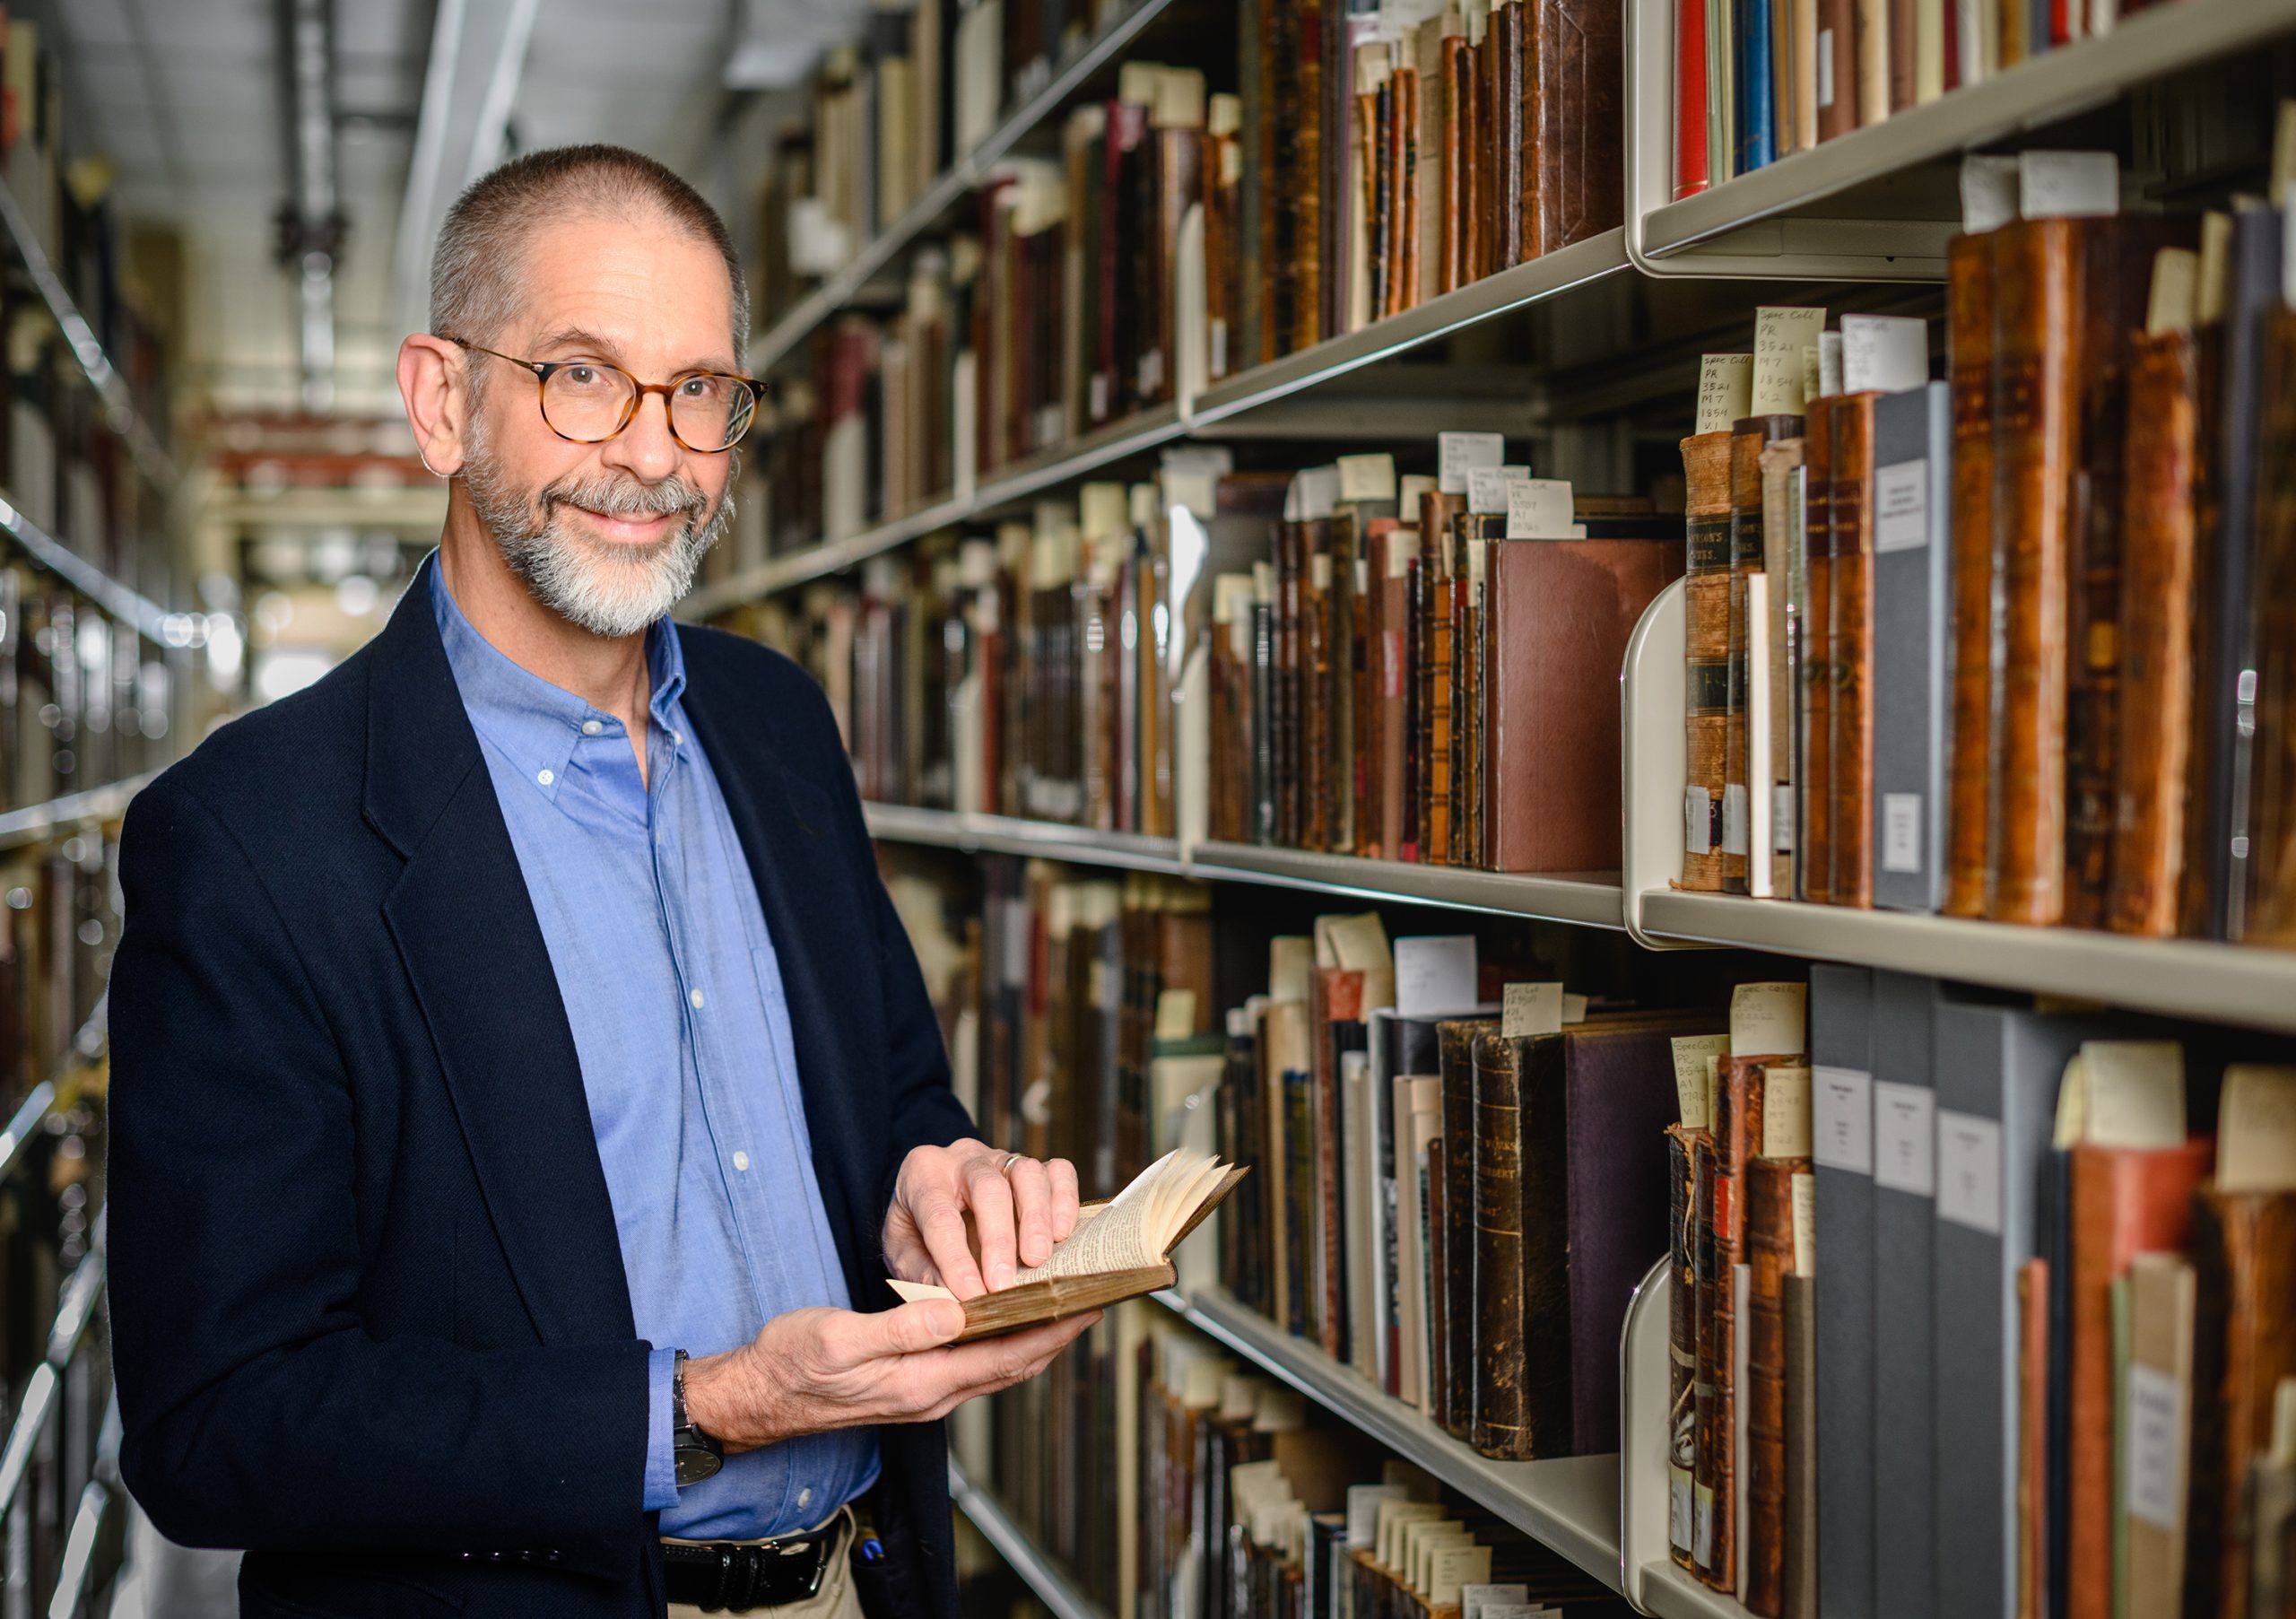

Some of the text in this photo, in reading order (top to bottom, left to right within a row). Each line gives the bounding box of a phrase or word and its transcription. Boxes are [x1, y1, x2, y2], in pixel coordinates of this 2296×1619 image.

[1760, 323, 1778, 336] PR
[1705, 369, 1718, 379] PR
[1702, 382, 1729, 392] 3521
[1701, 408, 1728, 418] 1854
